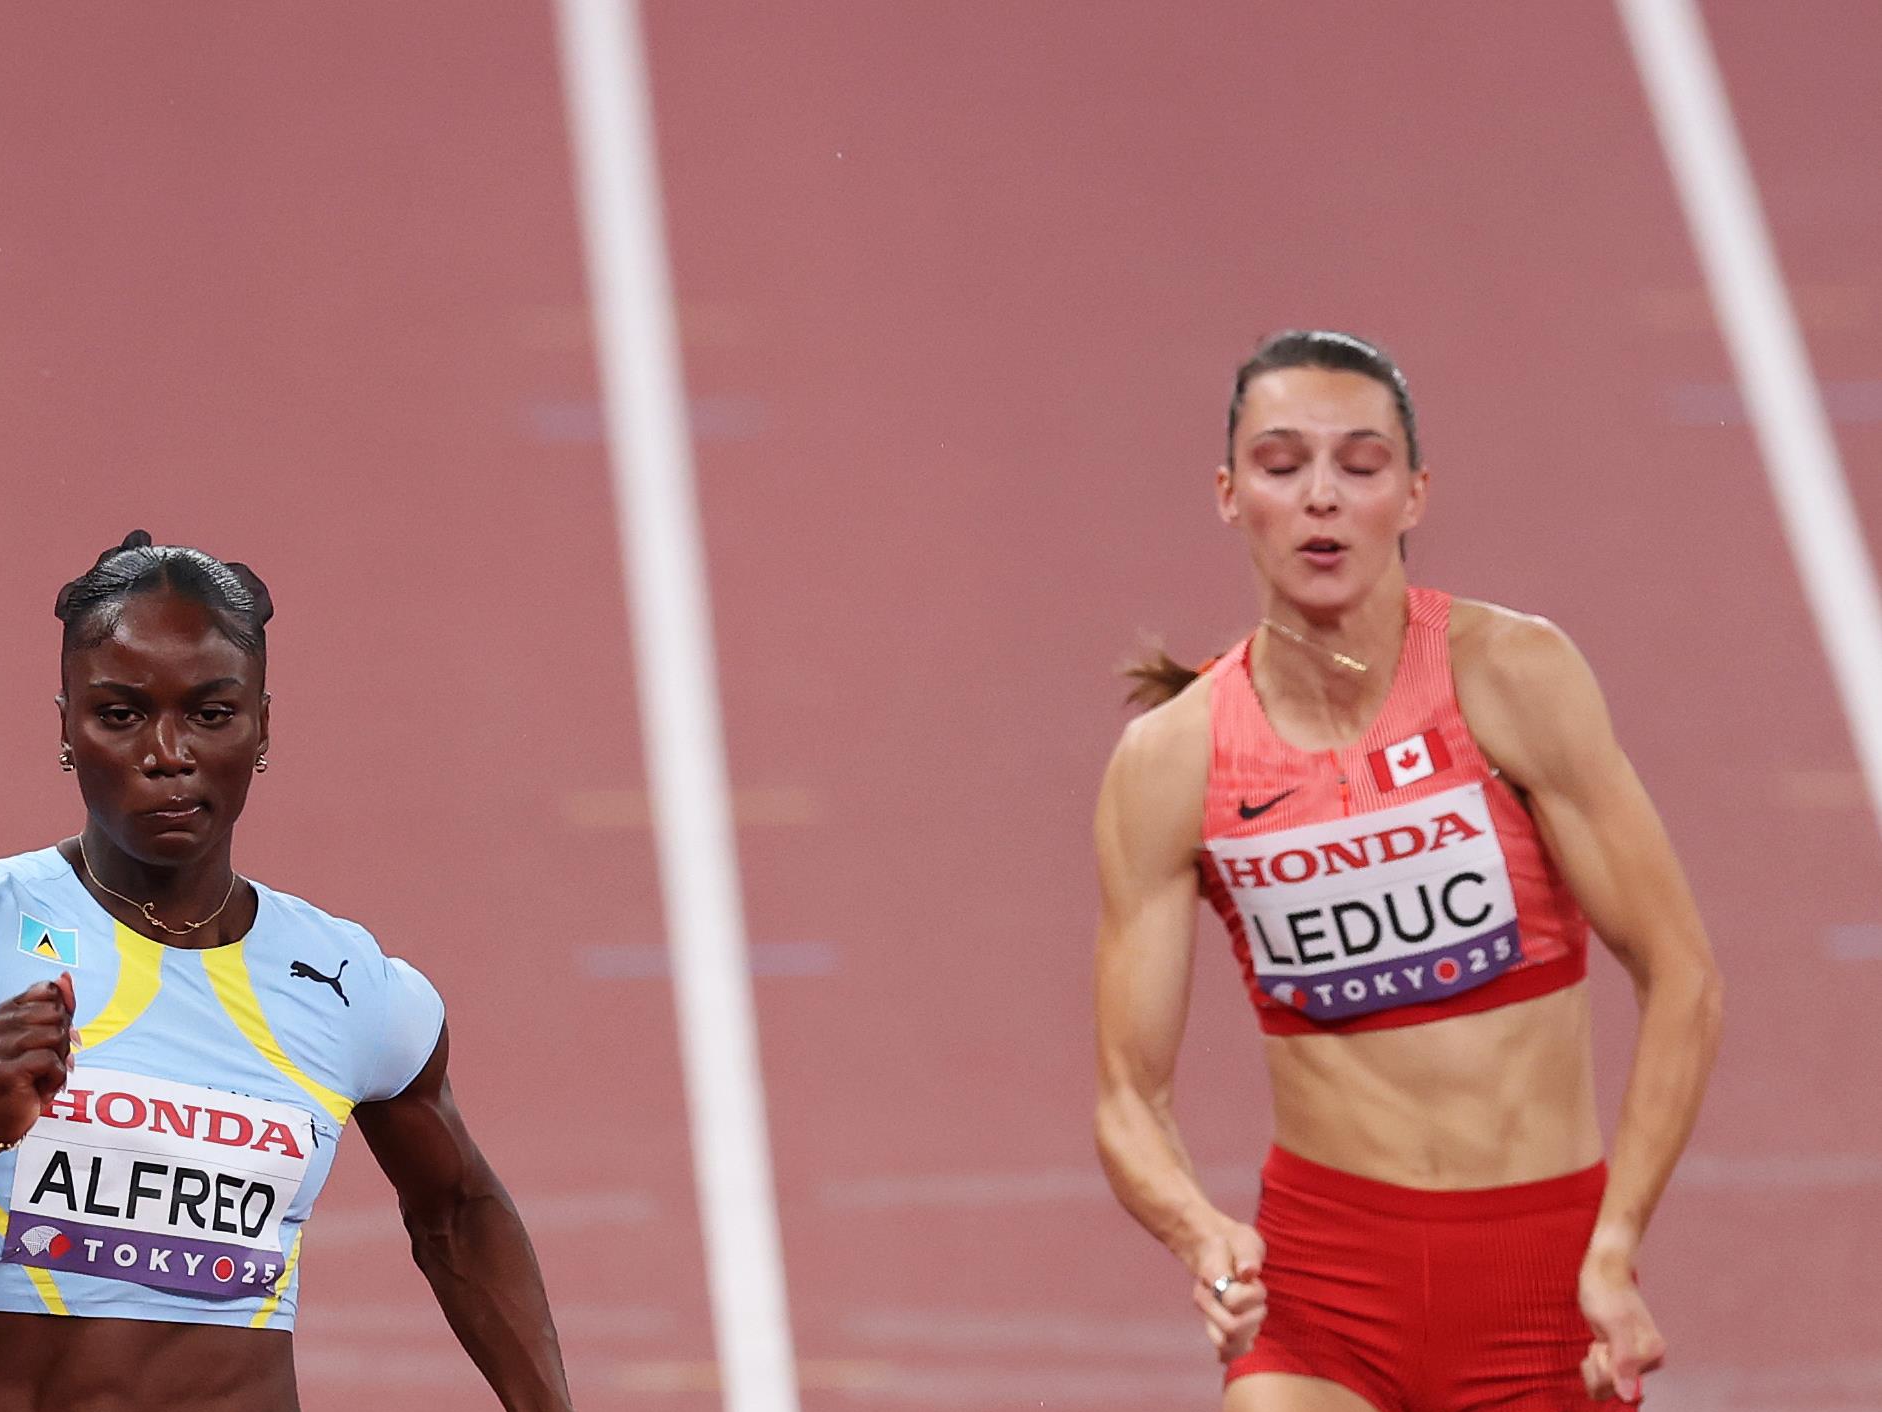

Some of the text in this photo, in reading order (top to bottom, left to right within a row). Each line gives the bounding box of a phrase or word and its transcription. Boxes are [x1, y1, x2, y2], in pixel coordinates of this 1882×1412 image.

[1222, 811, 1485, 889] HONDA
[1253, 872, 1494, 967] LEDUC
[39, 1088, 305, 1160] HONDA
[29, 1150, 276, 1239] ALFRED
